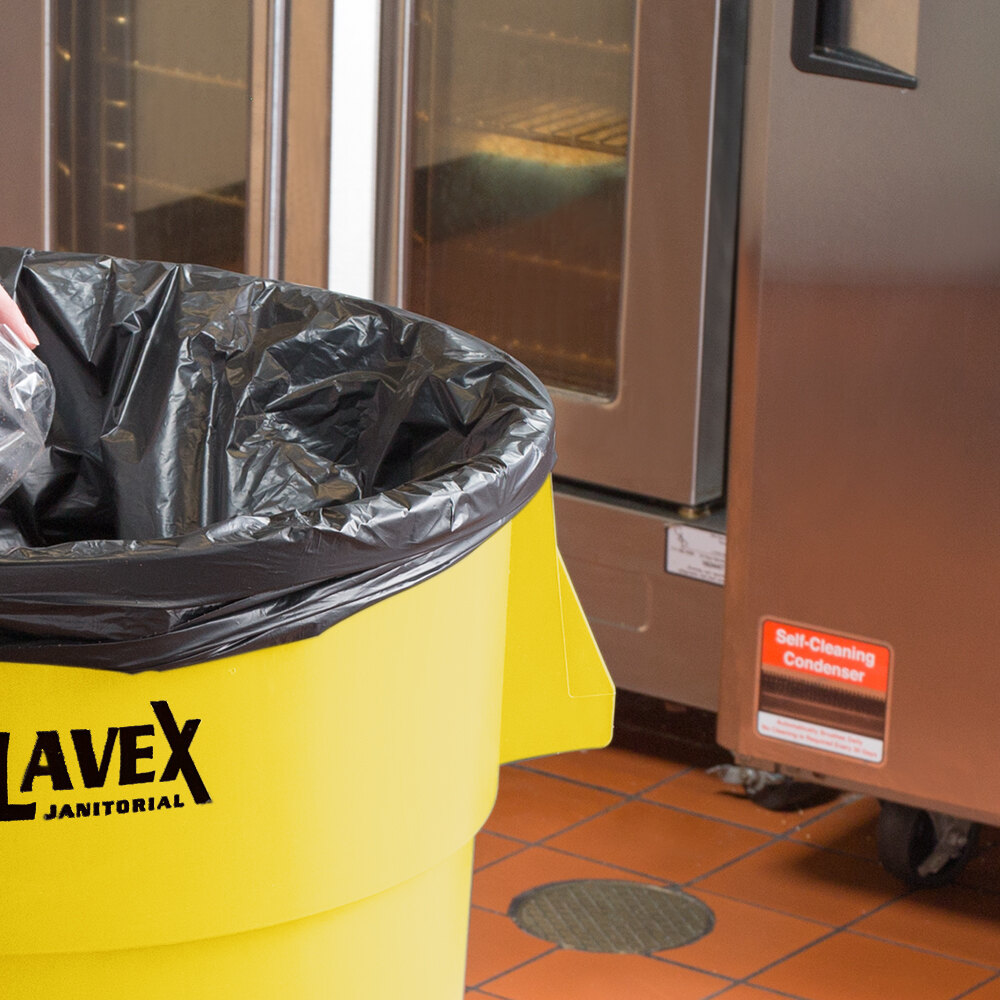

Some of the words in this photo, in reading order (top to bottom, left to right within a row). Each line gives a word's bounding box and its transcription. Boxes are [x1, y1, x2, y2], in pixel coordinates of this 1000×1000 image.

[775, 628, 876, 668] Self-Cleaning
[783, 651, 865, 682] Condenser
[43, 794, 185, 820] JANITORIAL
